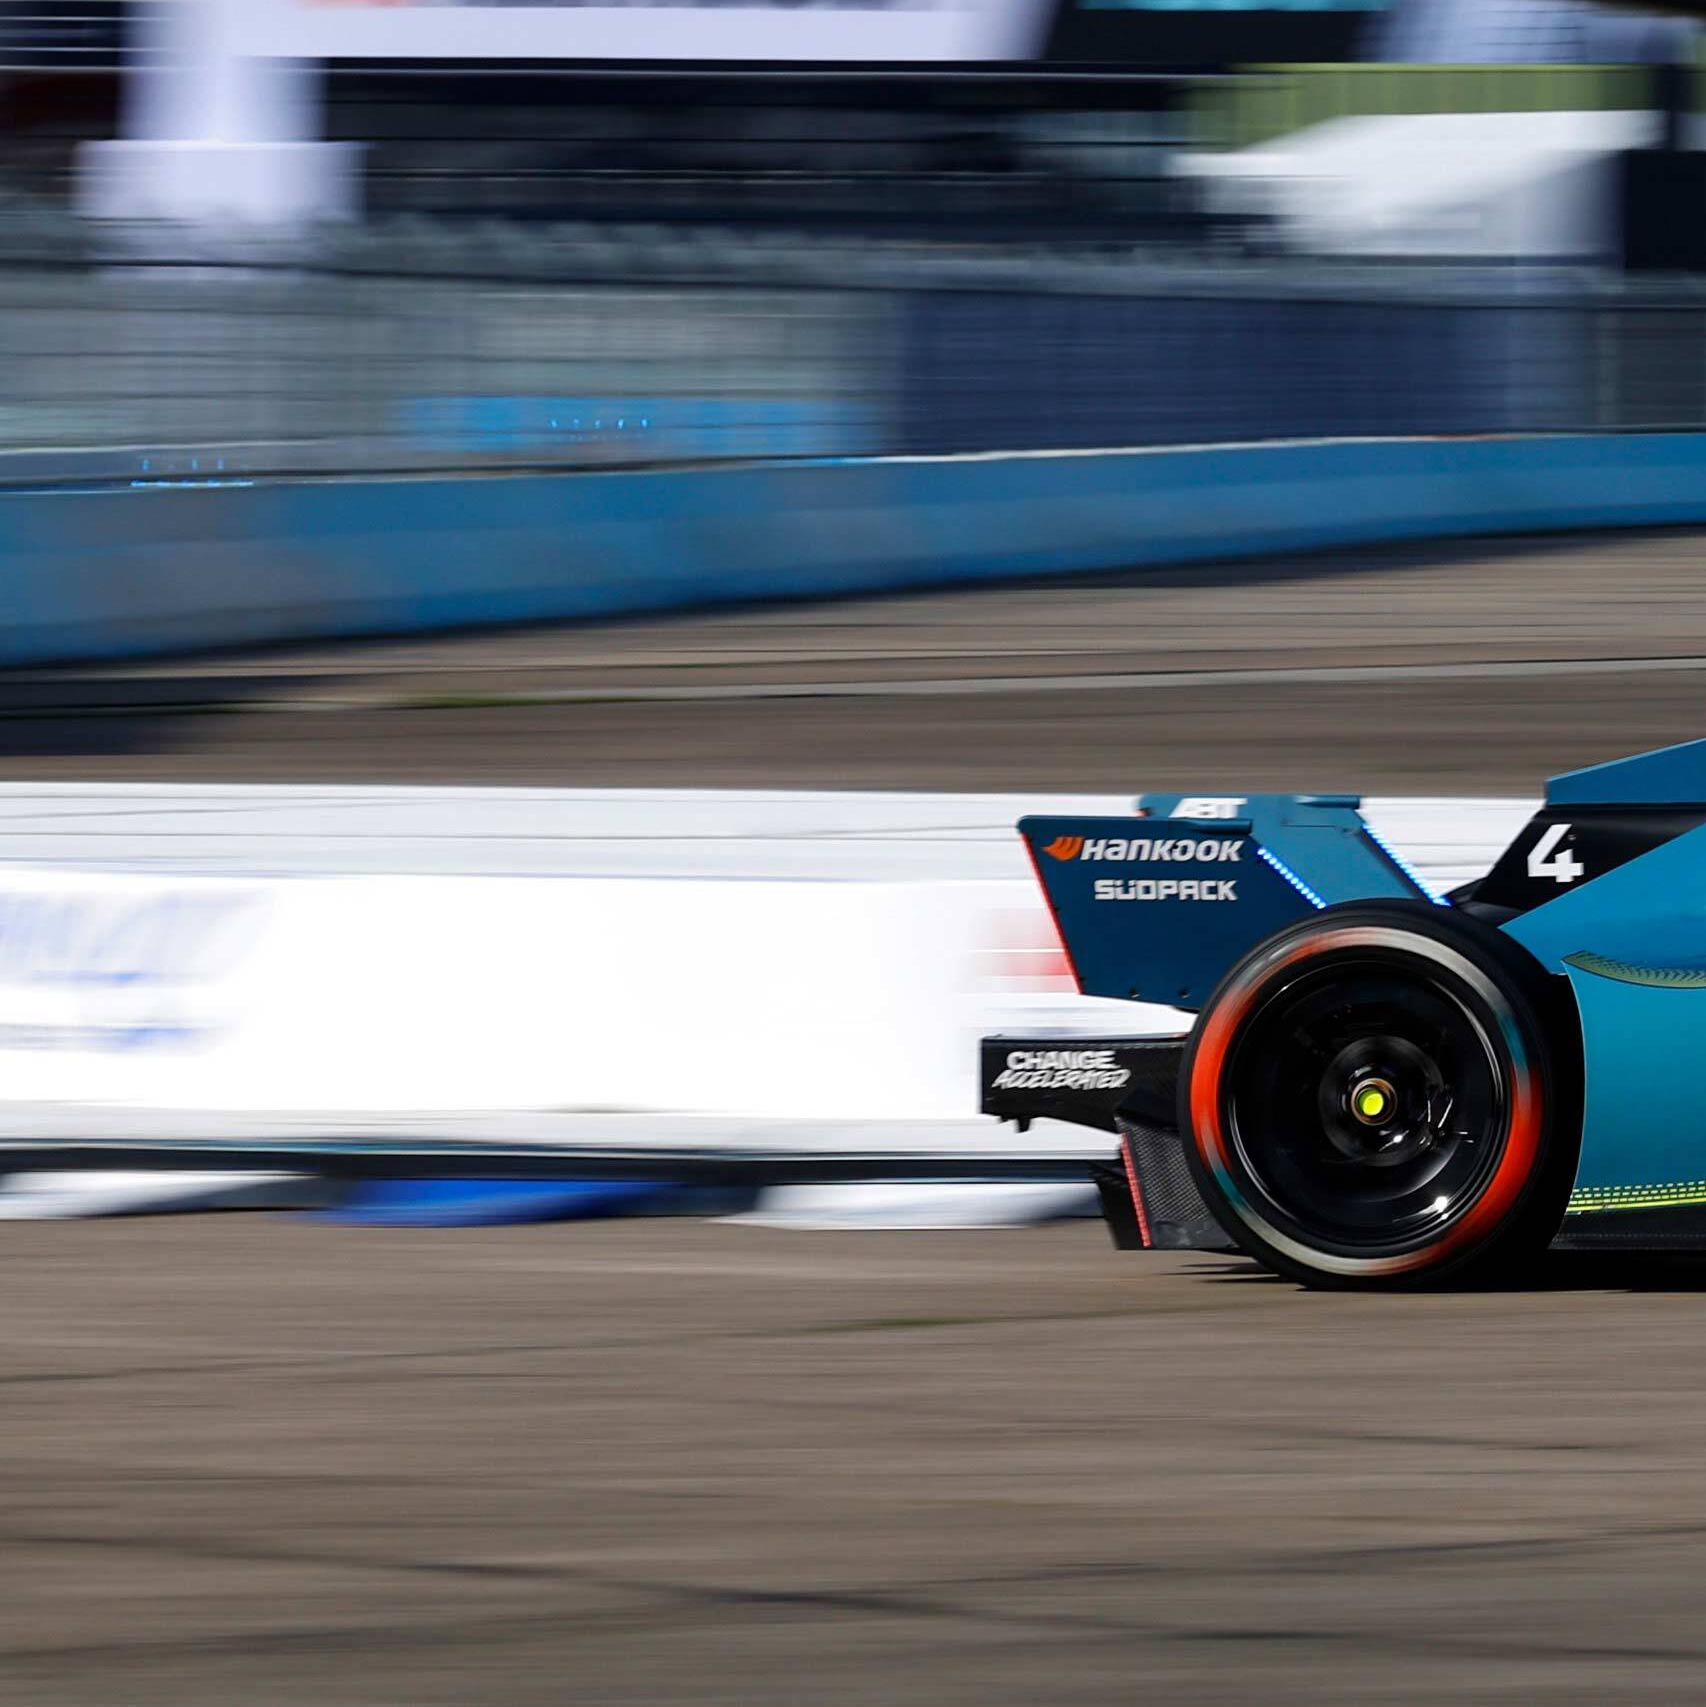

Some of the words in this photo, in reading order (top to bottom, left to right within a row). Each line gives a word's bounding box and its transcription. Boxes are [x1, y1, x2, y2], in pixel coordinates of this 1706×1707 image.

[1168, 797, 1249, 819] ABT
[1527, 823, 1584, 883] 4
[1094, 879, 1238, 901] SÜDPACK
[1006, 1050, 1121, 1070] CHANGE
